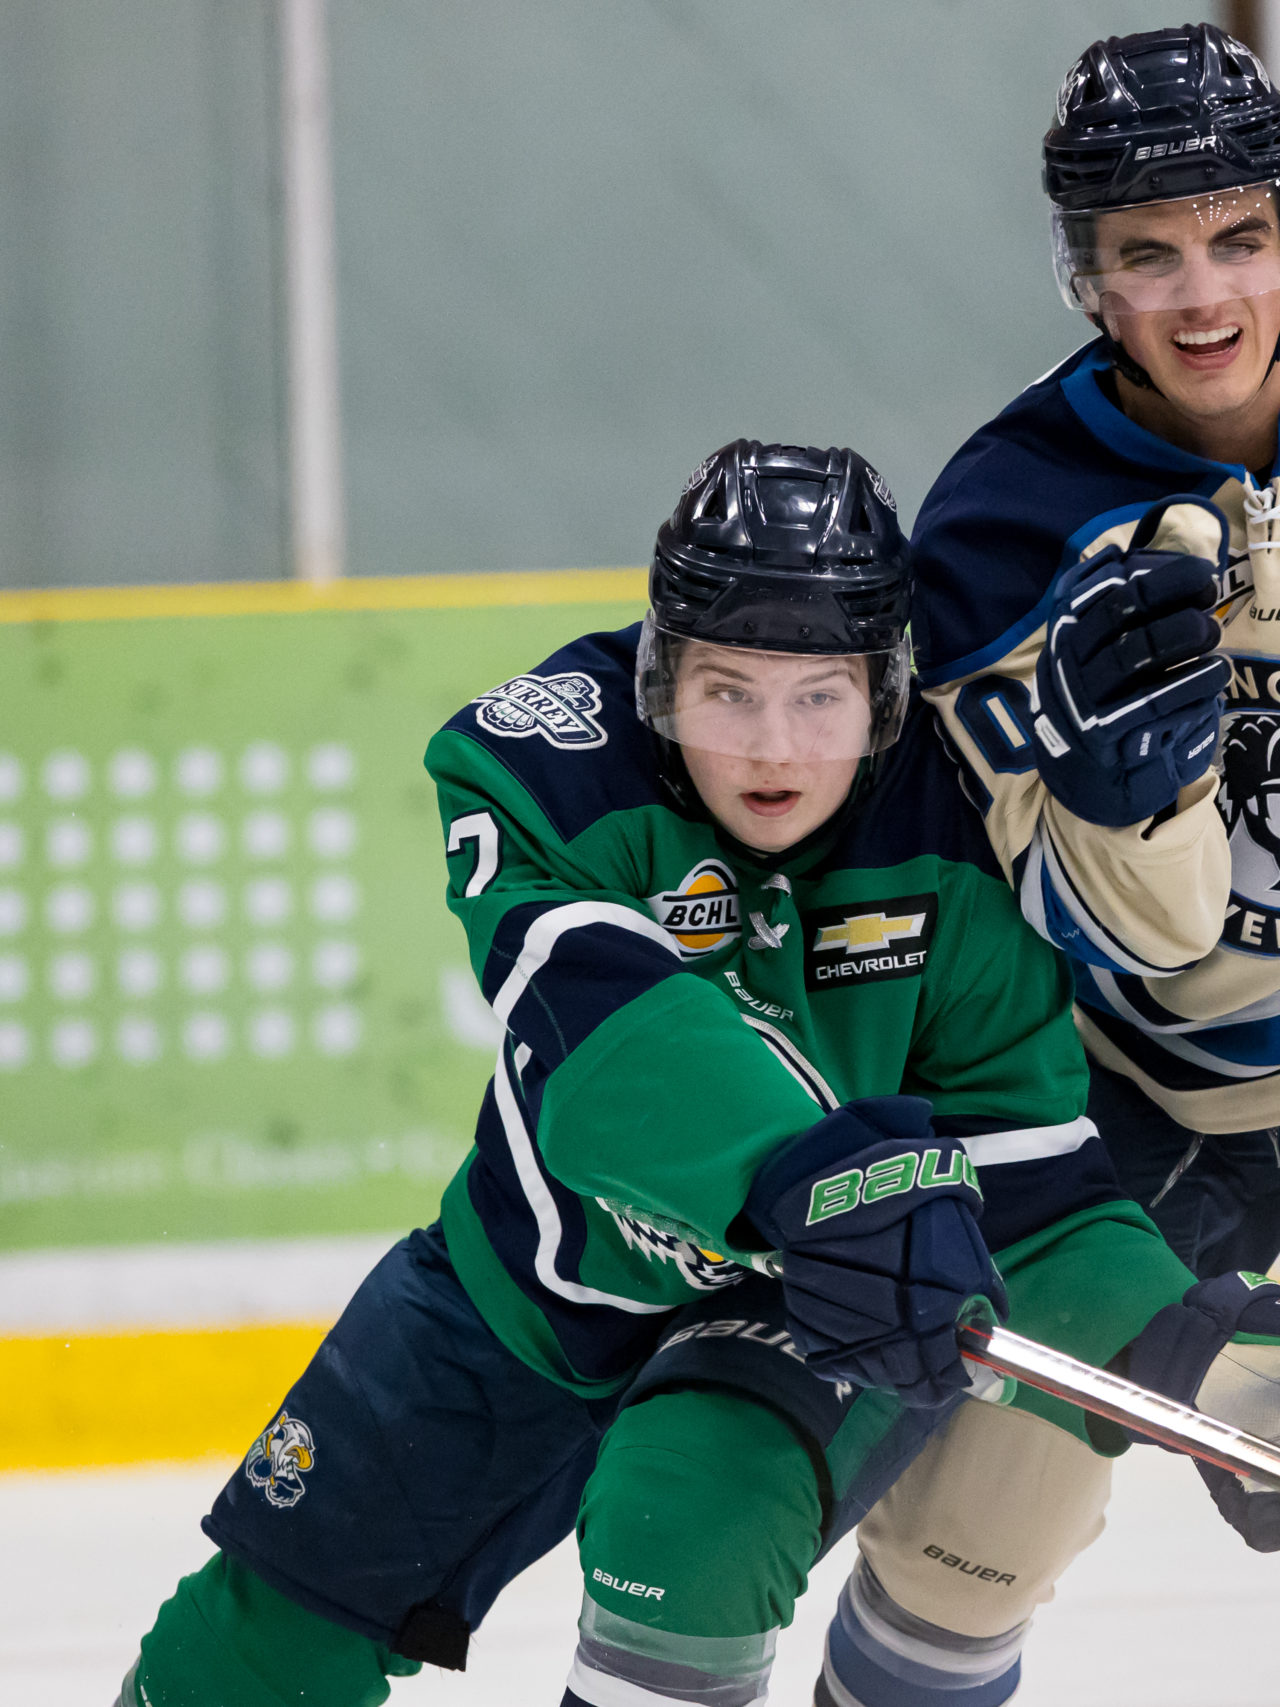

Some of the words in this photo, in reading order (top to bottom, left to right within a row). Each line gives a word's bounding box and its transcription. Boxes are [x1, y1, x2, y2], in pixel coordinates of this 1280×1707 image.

[1135, 135, 1217, 160] BAUER
[496, 683, 581, 728] SURREY
[663, 901, 739, 926] BCHL
[816, 950, 927, 980] CHEVROLET
[724, 971, 794, 1022] BAUER
[923, 1544, 1016, 1586] BAUER
[592, 1568, 665, 1600] BAUER
